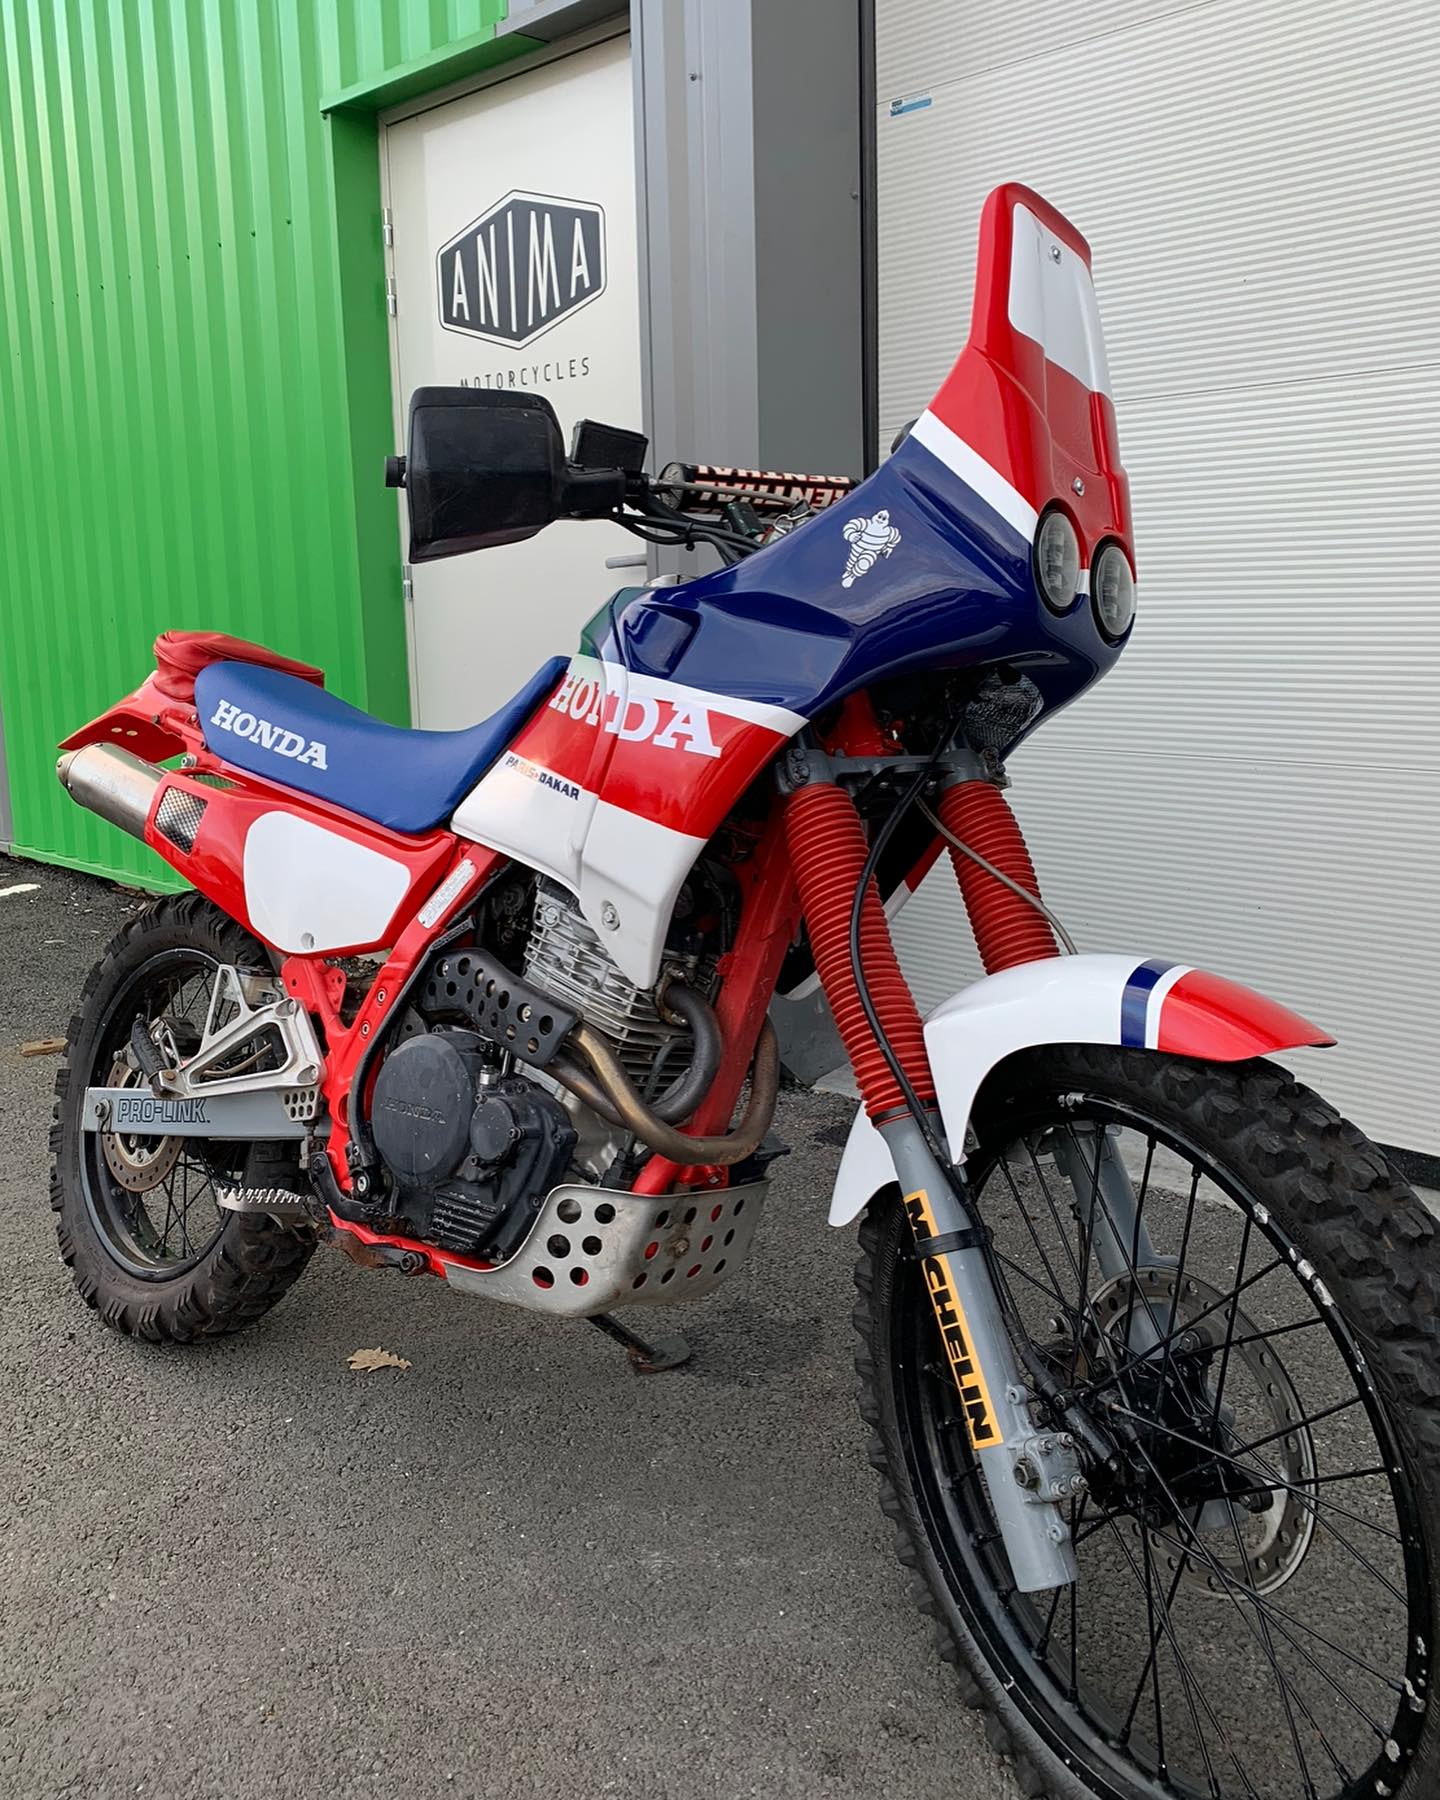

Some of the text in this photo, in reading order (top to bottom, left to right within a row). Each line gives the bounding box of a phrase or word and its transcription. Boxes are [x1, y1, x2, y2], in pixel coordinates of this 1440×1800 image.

[452, 210, 591, 332] ANIMA
[210, 699, 328, 770] HONDA
[548, 672, 722, 758] HONDA
[906, 1197, 994, 1441] MCHELIN
